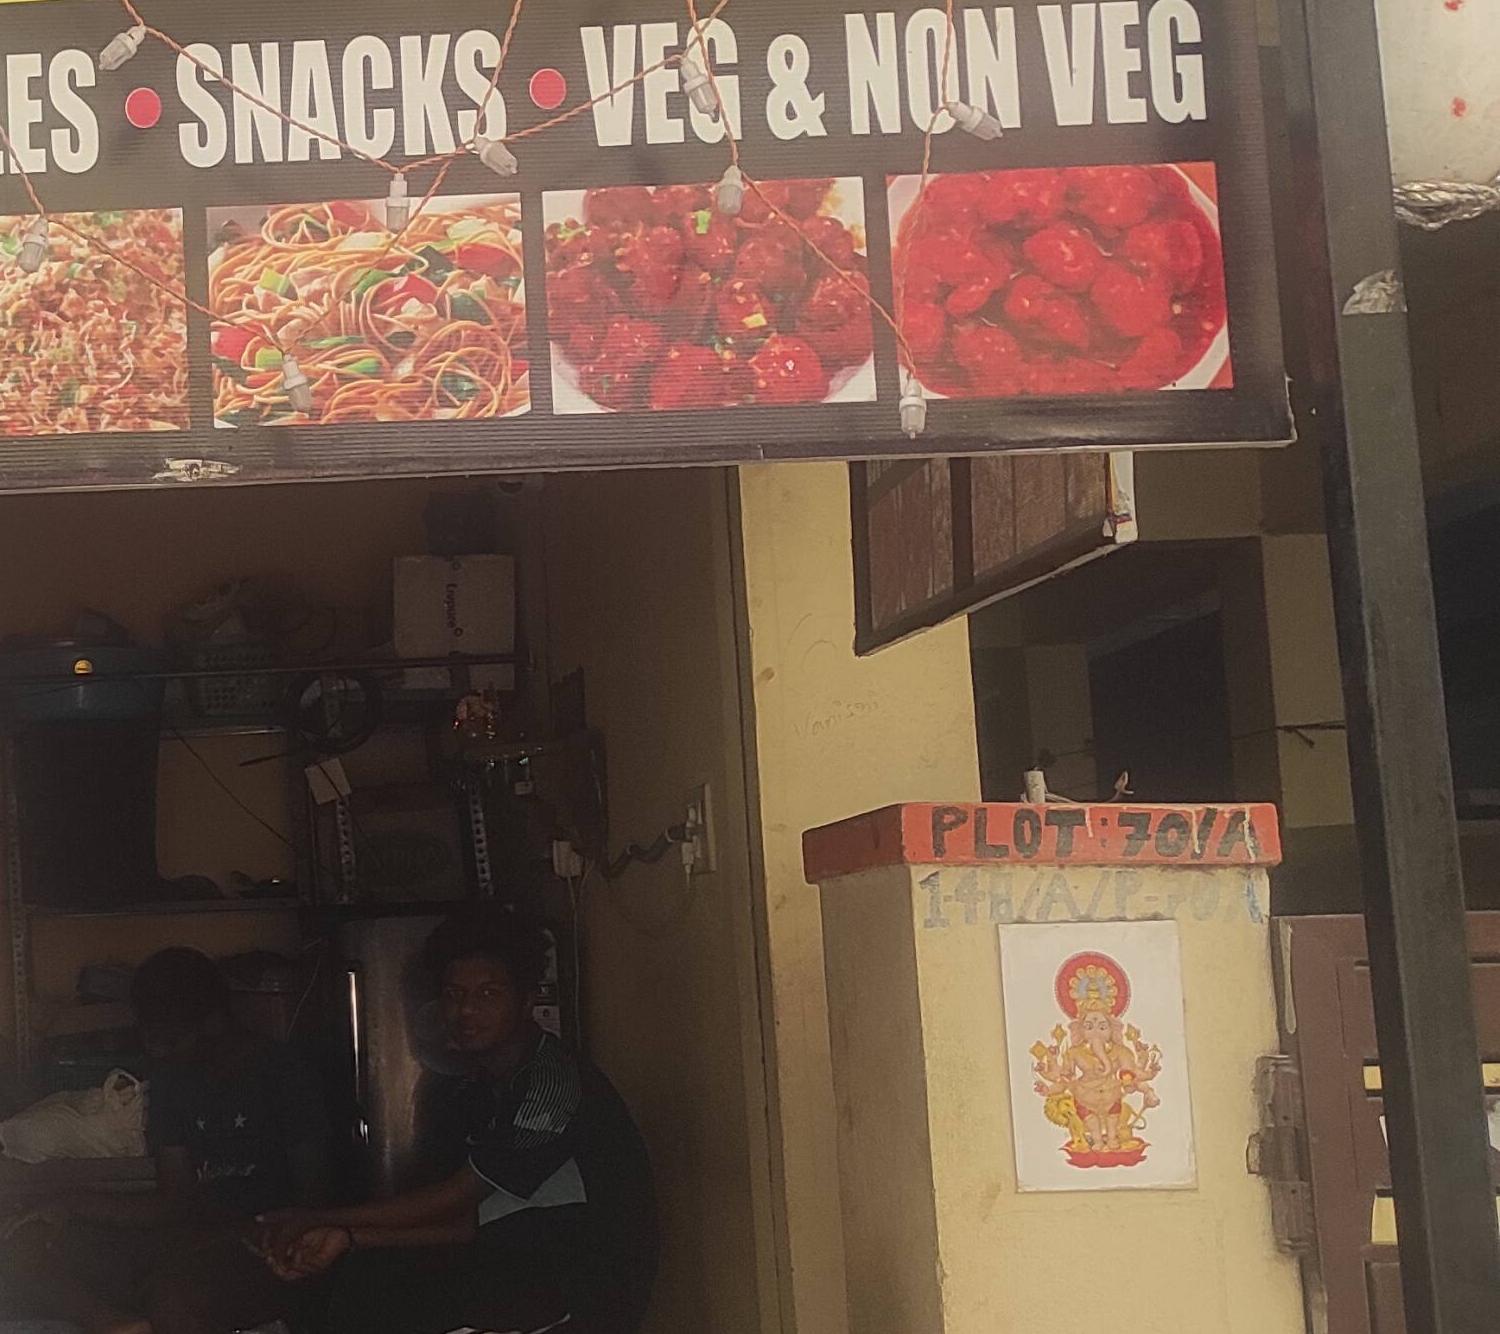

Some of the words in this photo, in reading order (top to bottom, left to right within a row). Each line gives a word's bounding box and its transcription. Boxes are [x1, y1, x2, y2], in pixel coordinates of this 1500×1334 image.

[175, 28, 506, 166] SNACKS
[580, 18, 739, 149] VEG
[766, 33, 828, 140] &
[844, 6, 1022, 136] NON
